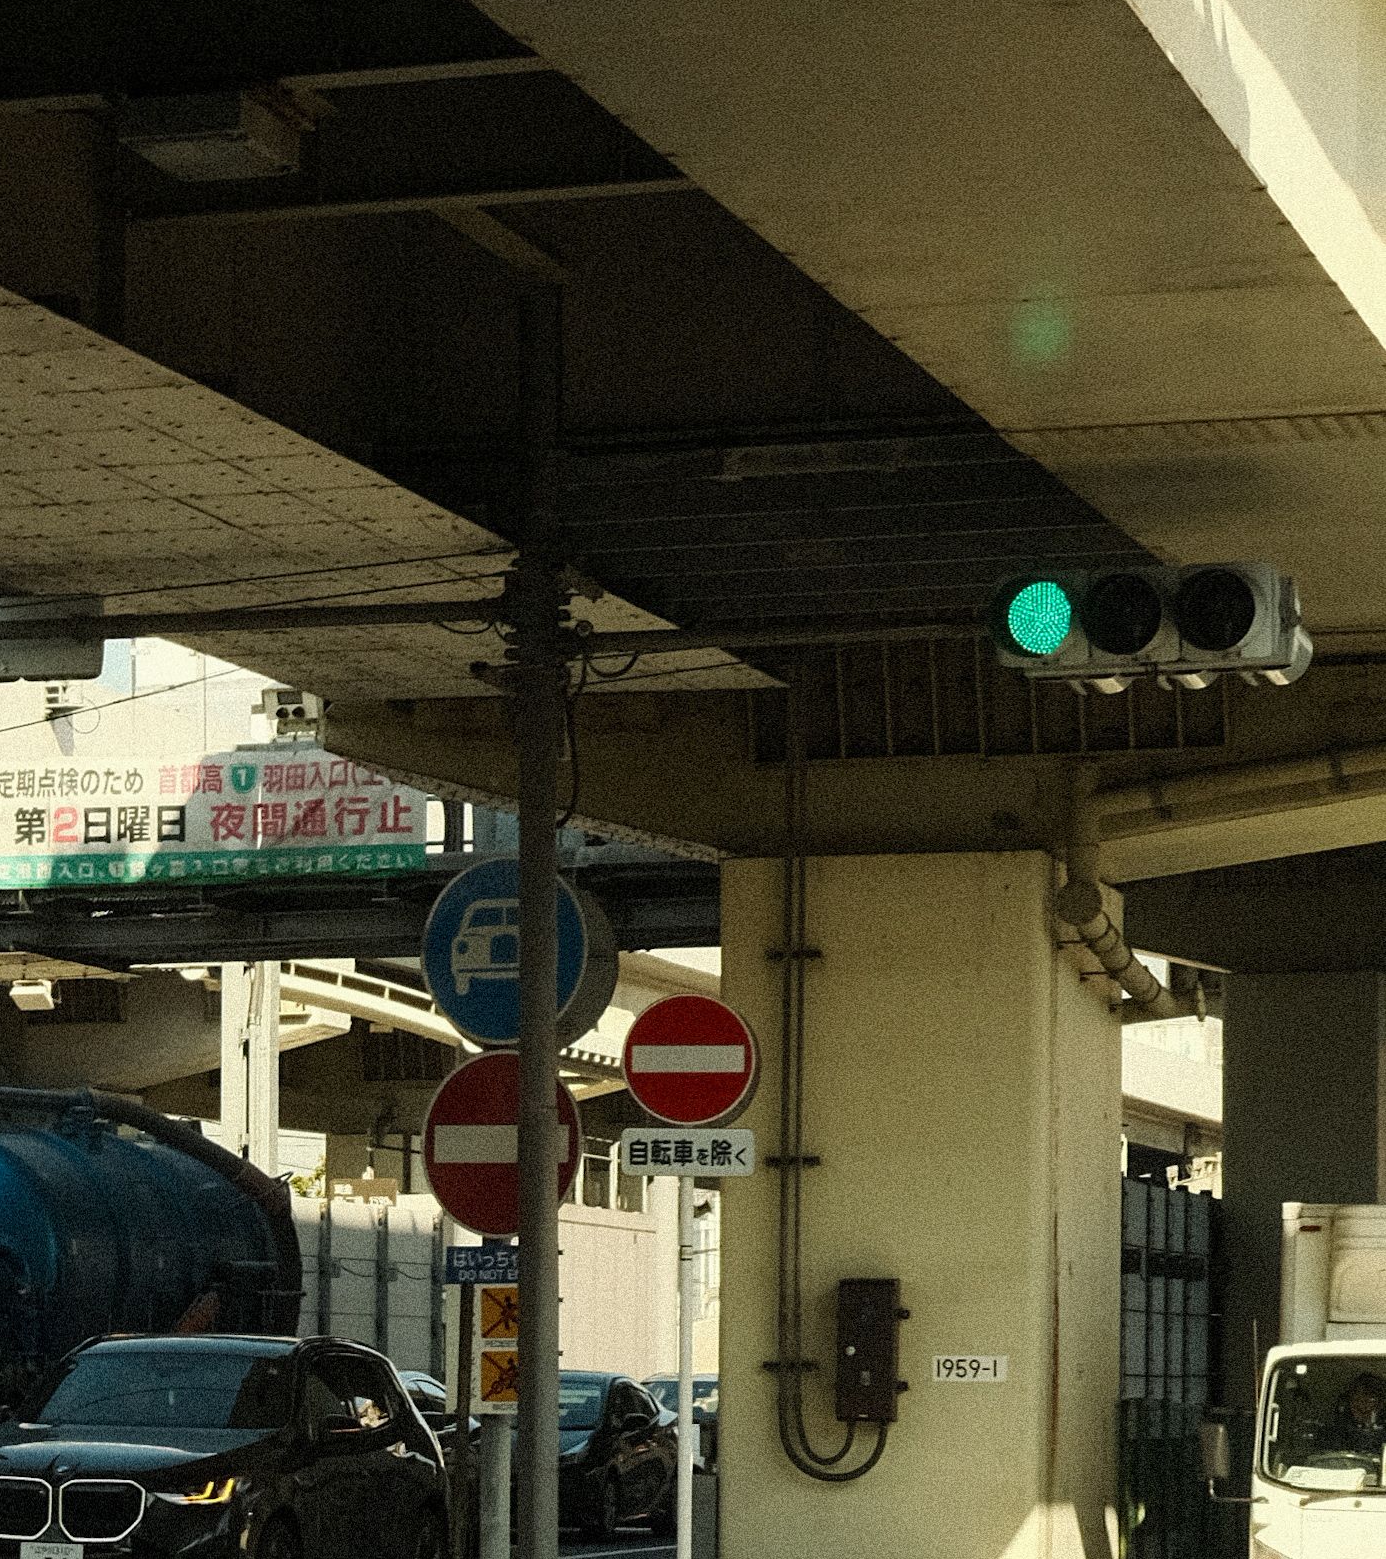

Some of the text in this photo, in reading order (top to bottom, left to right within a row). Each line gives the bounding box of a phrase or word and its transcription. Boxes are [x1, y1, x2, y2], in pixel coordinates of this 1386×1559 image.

[158, 764, 224, 794] 首都高
[15, 805, 186, 845] 第2日曜日
[209, 794, 414, 842] 夜間通行止
[629, 1138, 747, 1167] 自転車を除く
[459, 1270, 476, 1282] DO
[479, 1269, 505, 1281] NOT
[936, 1358, 997, 1379] 1959-1
